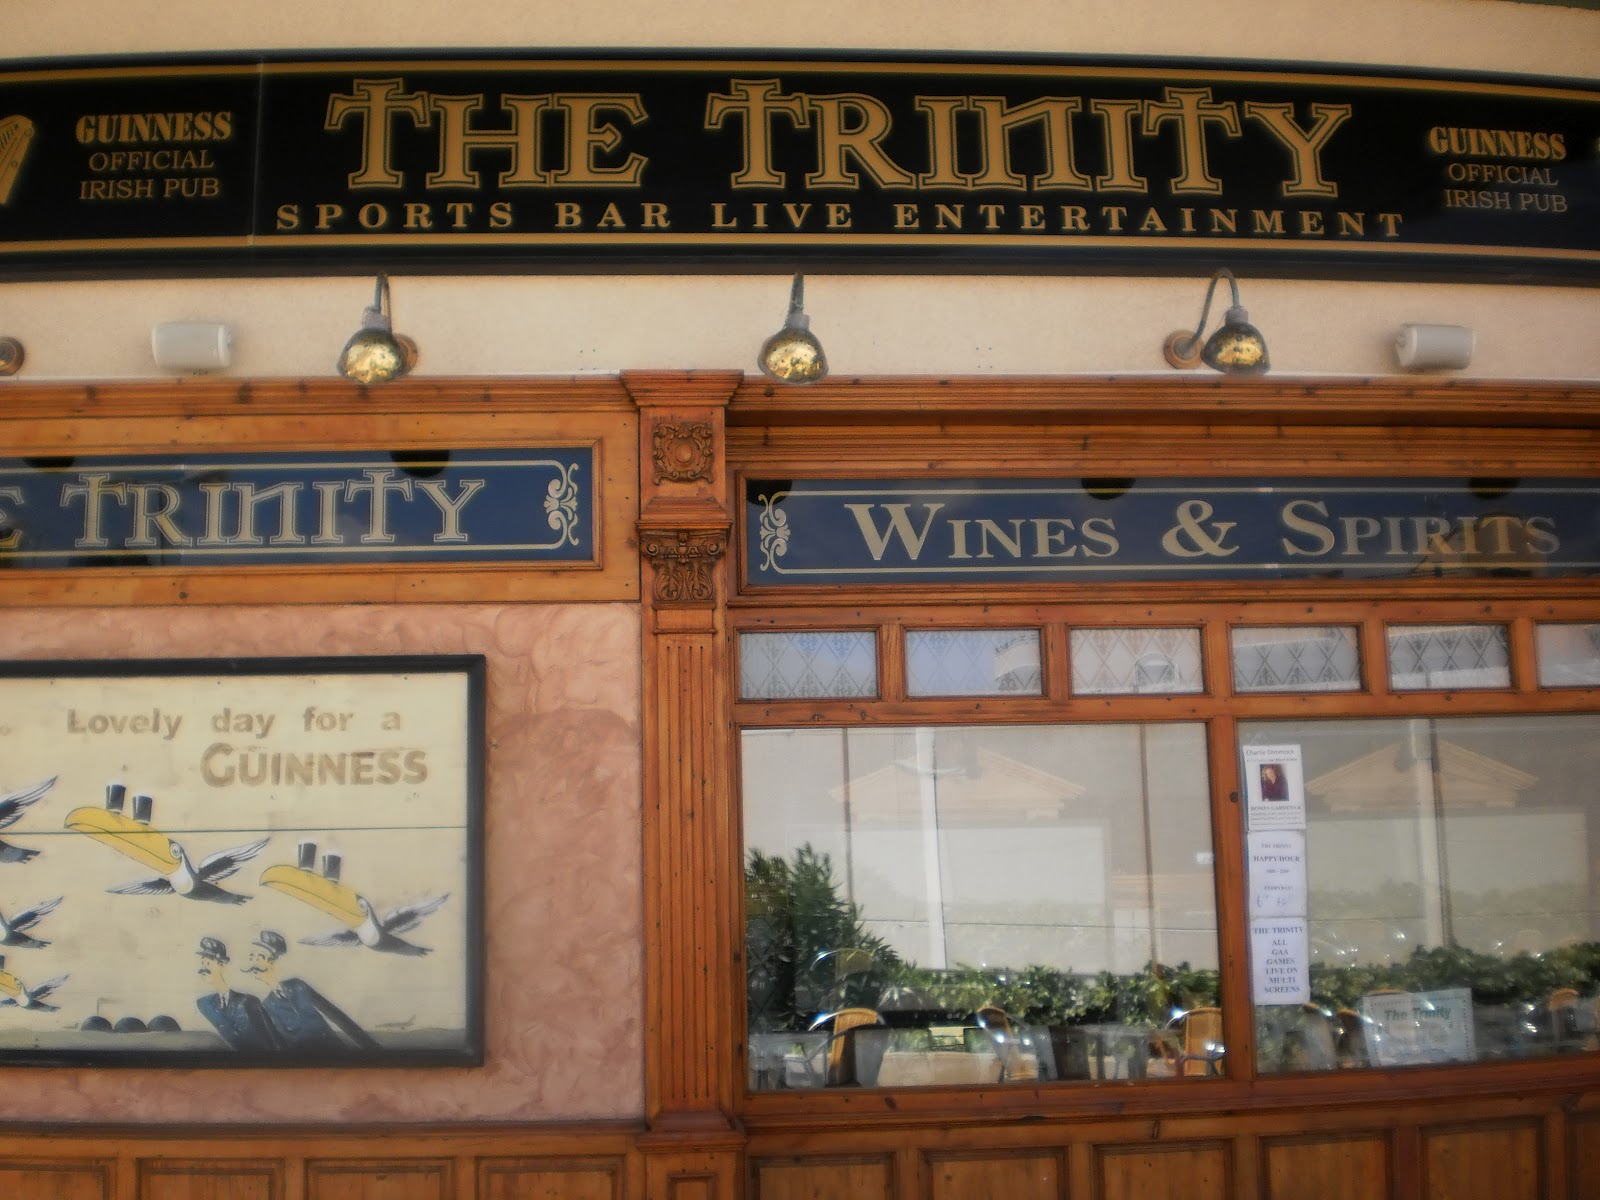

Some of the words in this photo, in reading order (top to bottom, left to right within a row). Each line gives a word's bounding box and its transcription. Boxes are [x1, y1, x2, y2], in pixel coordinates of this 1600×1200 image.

[75, 111, 233, 144] GUINNESS
[324, 78, 649, 188] THE
[704, 78, 1352, 197] TRINITY
[1429, 126, 1567, 161] GUINNESS
[88, 149, 214, 172] OFFICIAL
[1448, 162, 1558, 187] OFFICIAL
[79, 178, 156, 200] IRISH
[164, 176, 220, 198] PUB
[1445, 188, 1511, 211] IRISH
[1520, 192, 1568, 214] PUB
[276, 202, 513, 231] SPORTS
[555, 202, 671, 228] BAR
[711, 202, 853, 228] LIVE
[893, 203, 1403, 237] ENTERTAINMENT
[60, 469, 486, 548] TRINITY
[845, 501, 1120, 561] WINES
[1162, 499, 1239, 558] &
[1282, 499, 1560, 557] SPIRITS
[67, 708, 183, 740] Lovely
[210, 707, 276, 739] day
[303, 705, 354, 733] for
[380, 709, 402, 733] a
[201, 741, 429, 788] GUINNESS
[1254, 927, 1270, 935] THE
[1272, 926, 1304, 934] TRINITY
[1266, 958, 1296, 966] GAMES
[1271, 948, 1289, 956] GAA
[1265, 967, 1285, 975] LIVE
[1269, 976, 1296, 984] MULTI
[1264, 985, 1301, 994] SCREENS
